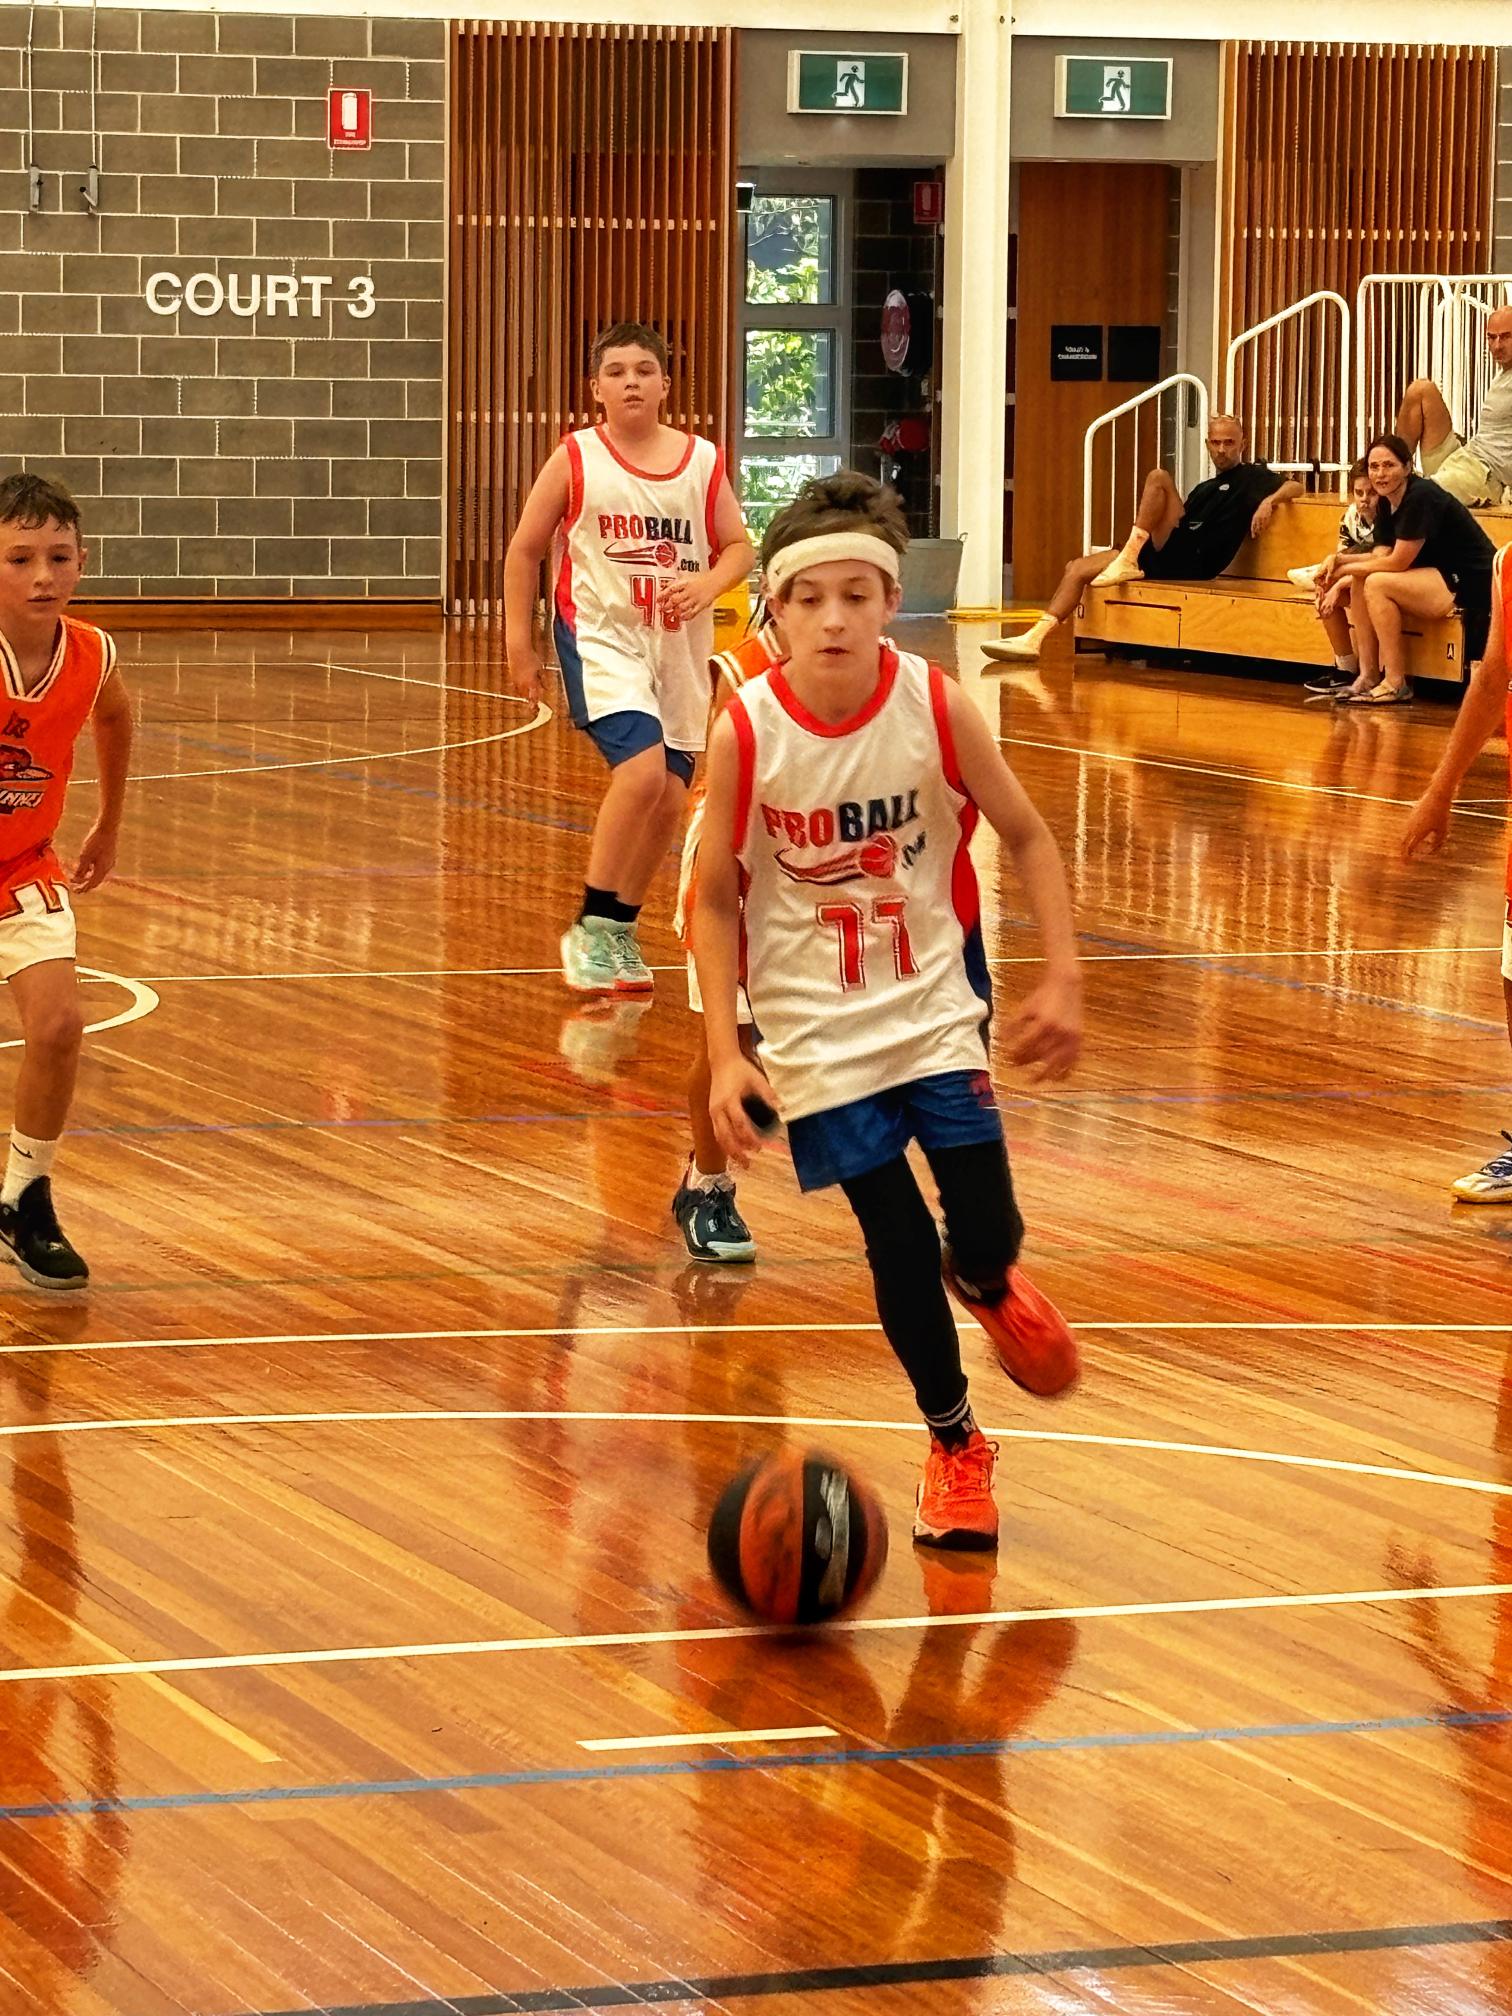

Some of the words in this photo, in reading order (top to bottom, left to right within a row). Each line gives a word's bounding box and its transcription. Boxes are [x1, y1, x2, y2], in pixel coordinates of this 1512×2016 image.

[146, 271, 333, 317] COURT
[347, 276, 376, 318] 3
[598, 514, 693, 545] PROBALL
[761, 788, 919, 849] PROBALL
